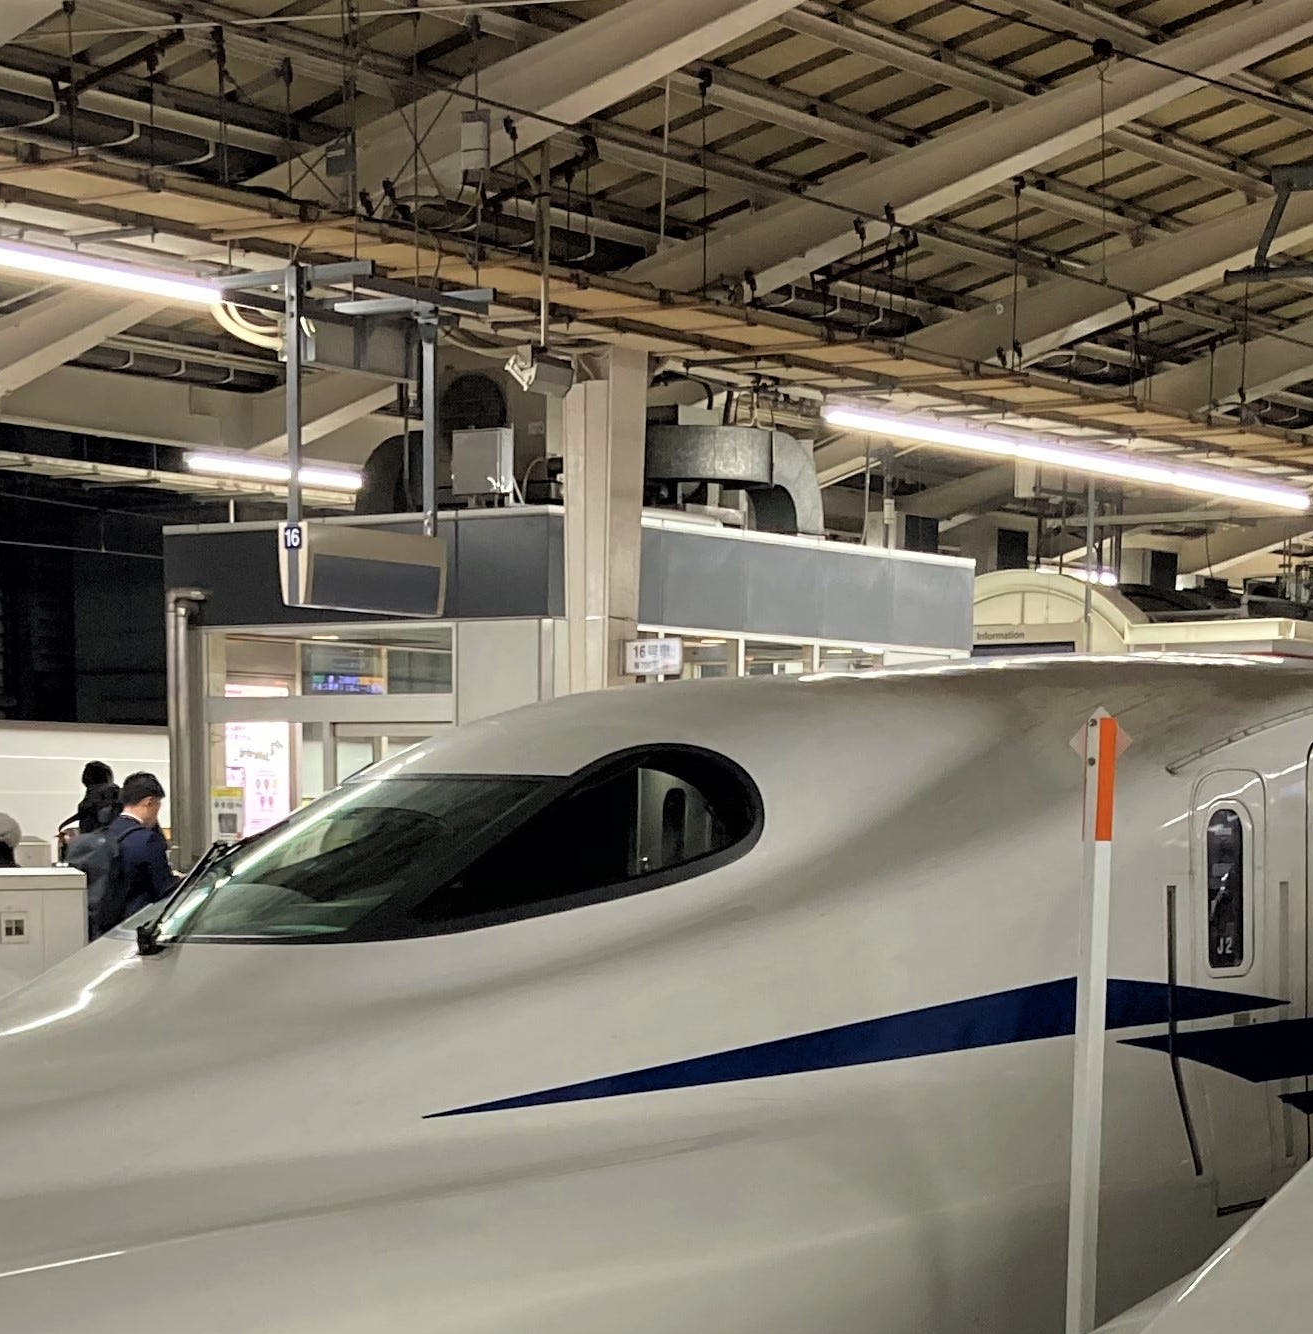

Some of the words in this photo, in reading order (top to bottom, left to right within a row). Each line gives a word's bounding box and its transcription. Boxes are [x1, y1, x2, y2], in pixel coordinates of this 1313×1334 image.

[285, 528, 300, 547] 16
[633, 645, 646, 658] 16
[1217, 936, 1233, 955] J2
